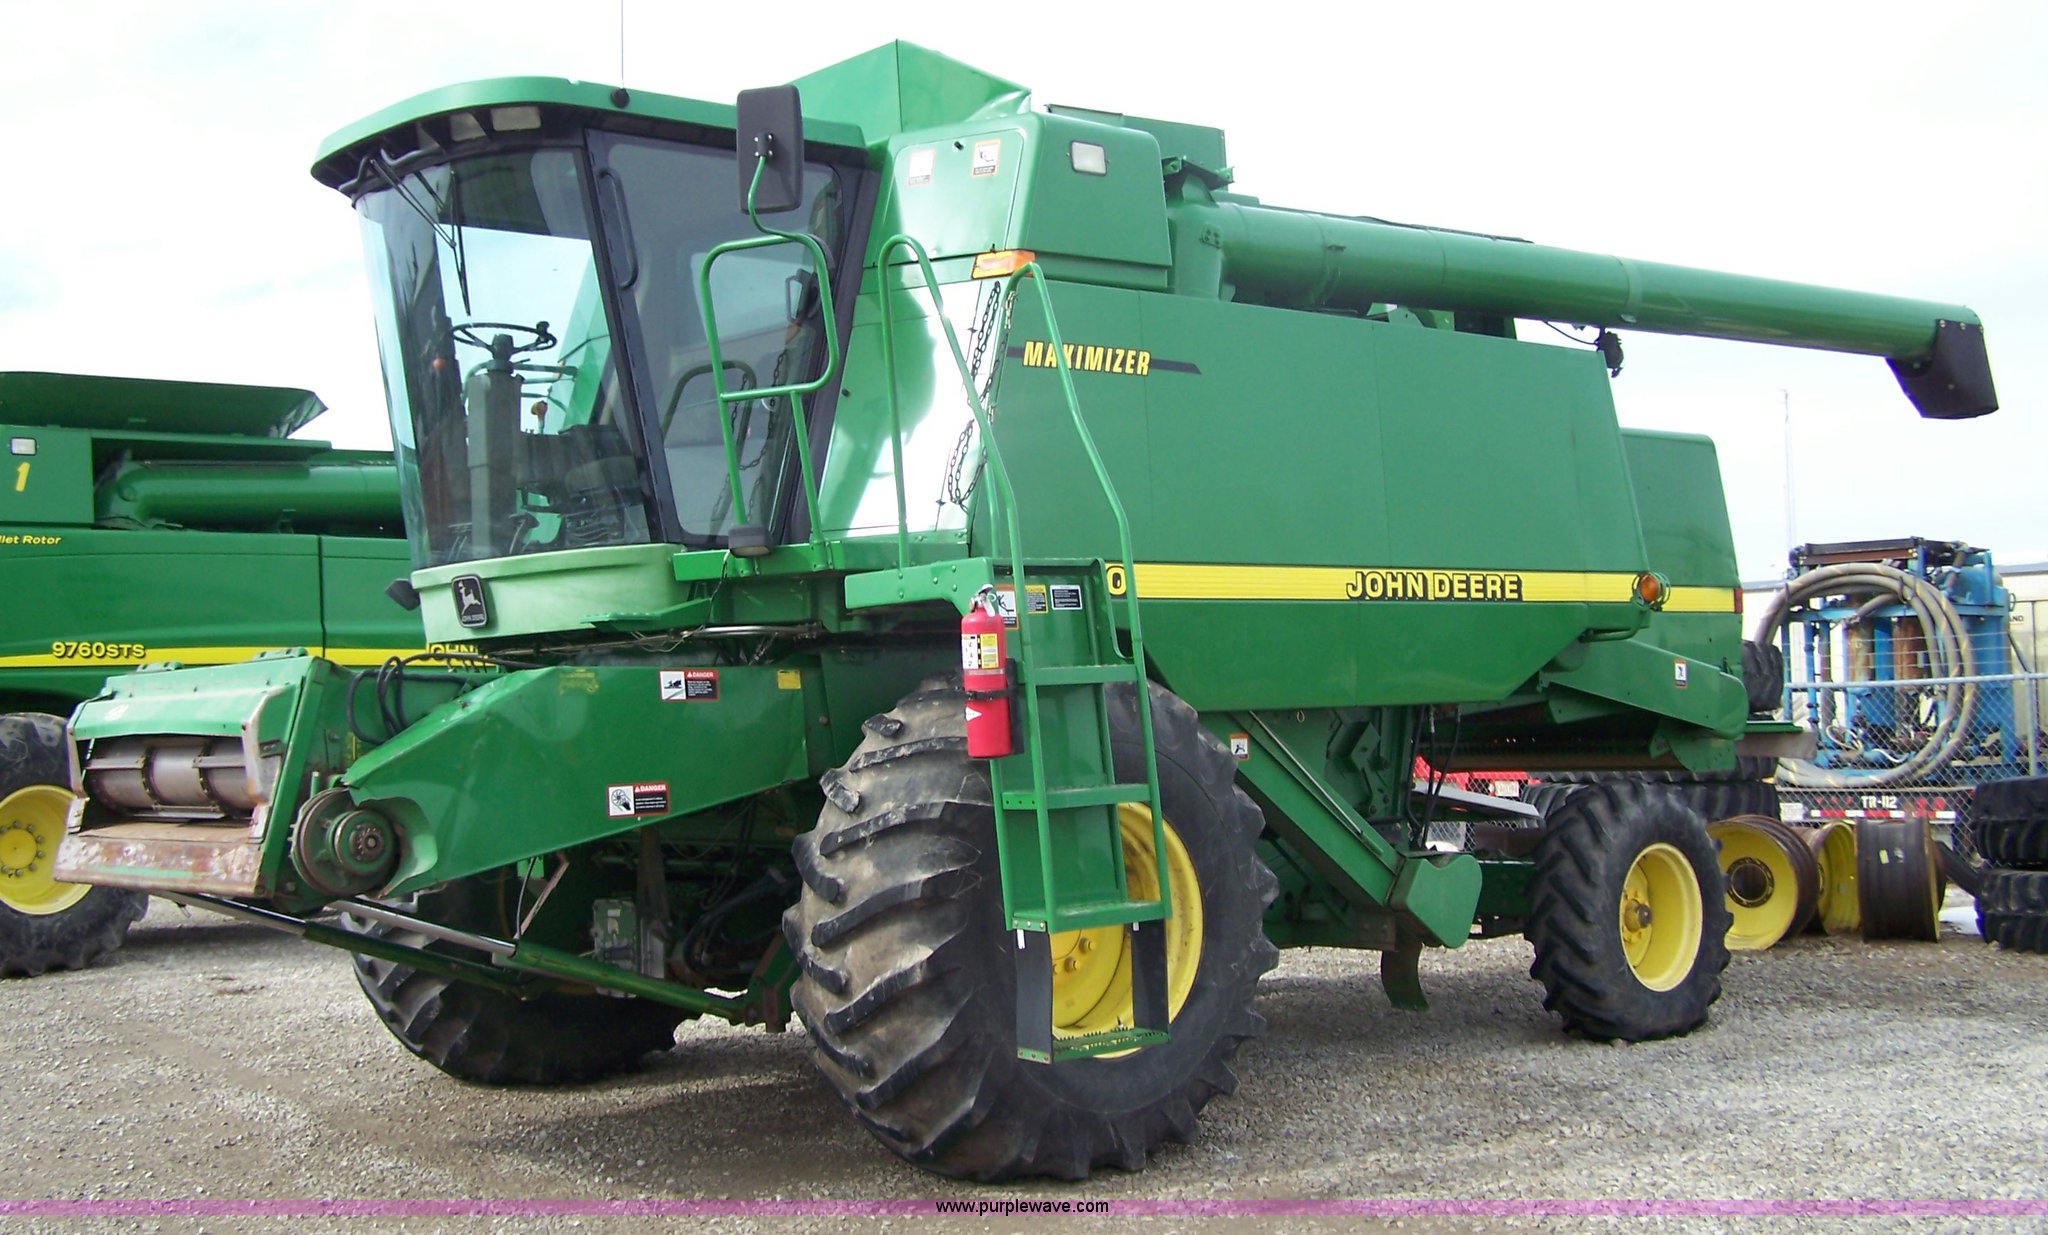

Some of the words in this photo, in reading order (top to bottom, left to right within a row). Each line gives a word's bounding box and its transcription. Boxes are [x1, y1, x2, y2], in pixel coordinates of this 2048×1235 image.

[1022, 340, 1151, 376] MAXIMIZER
[15, 461, 31, 492] 1
[22, 535, 62, 545] Rotor
[1346, 571, 1428, 600] JOHN
[1432, 572, 1523, 601] DEERE
[51, 641, 146, 658] 9760STS
[640, 784, 667, 792] DANGER
